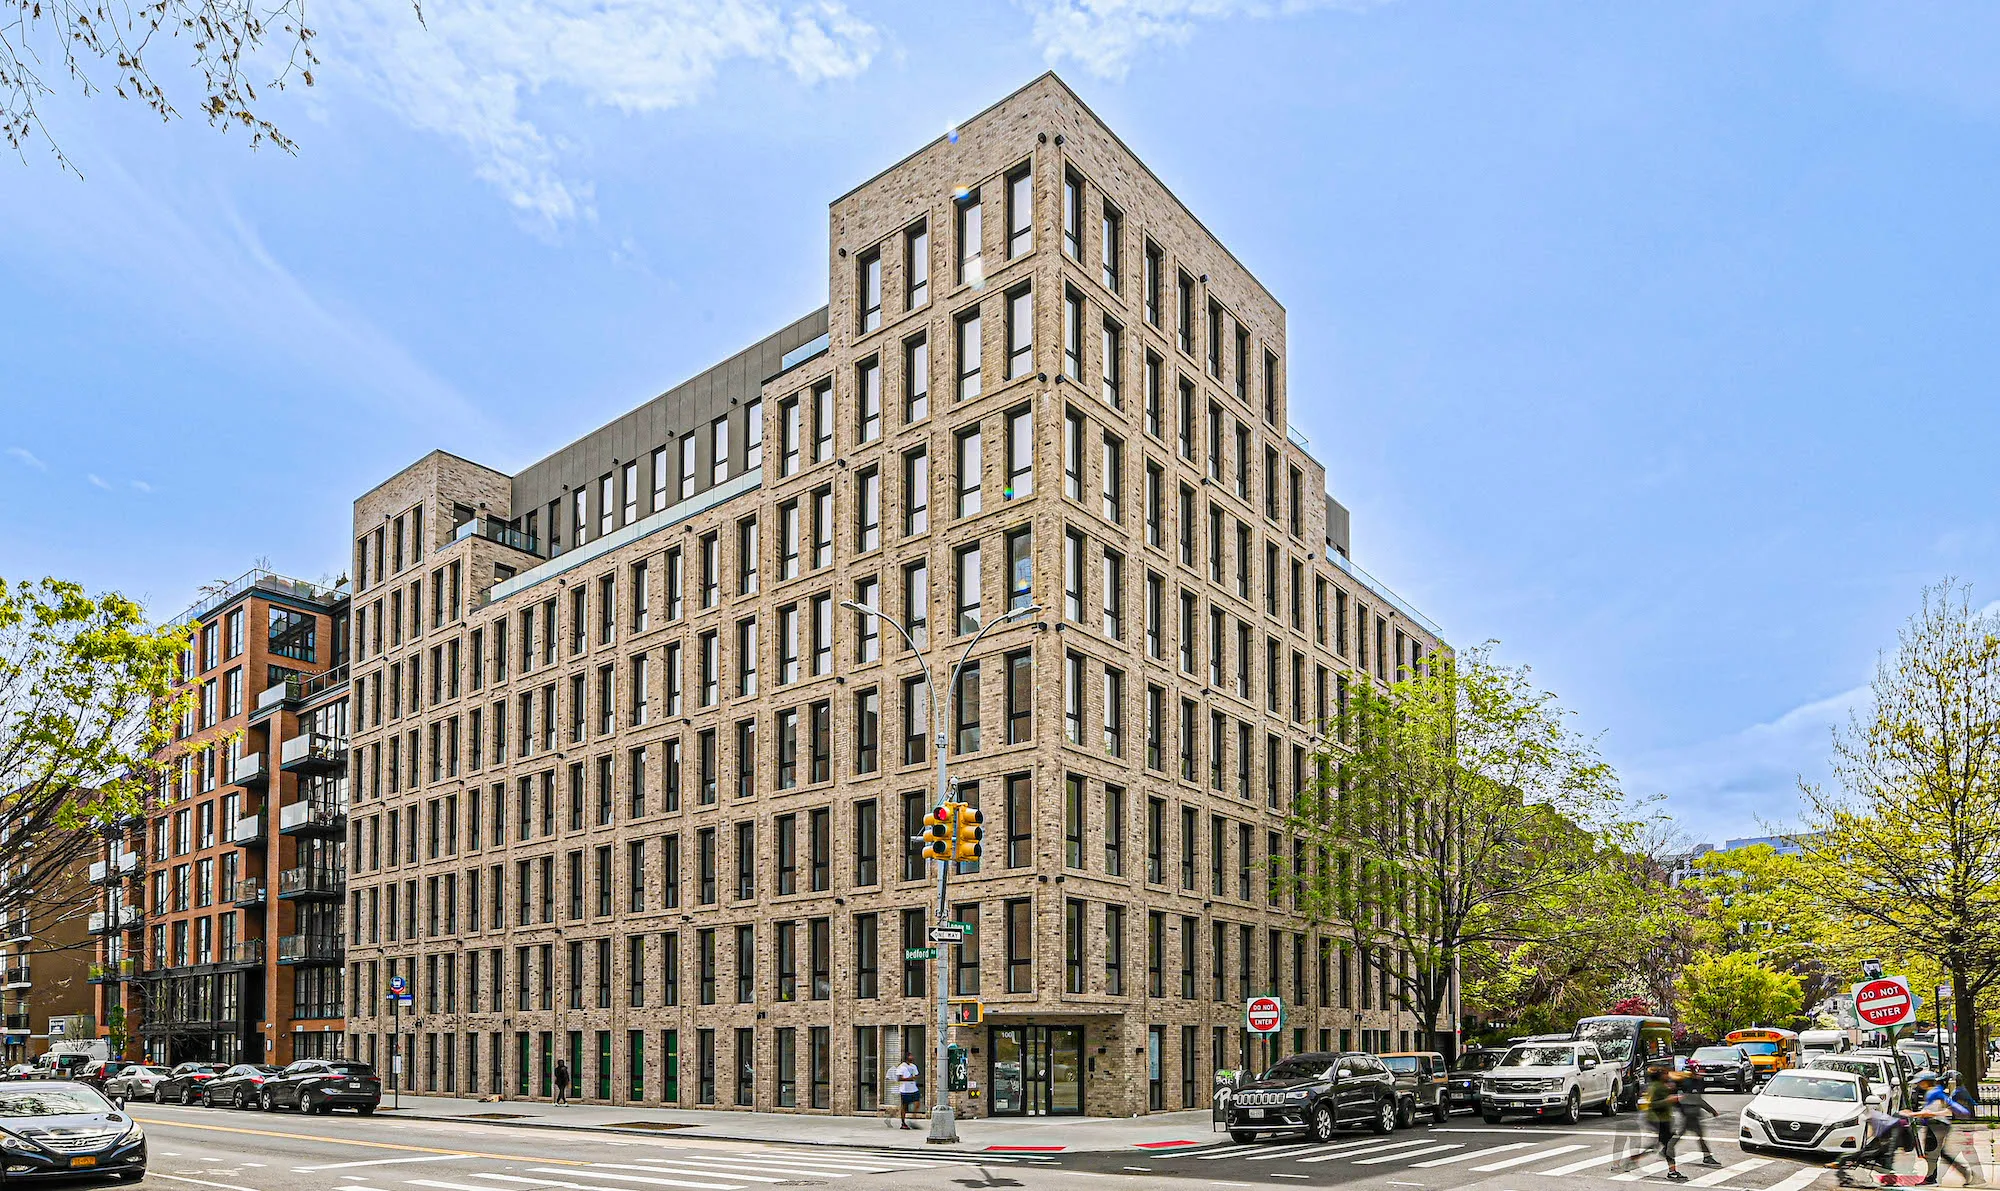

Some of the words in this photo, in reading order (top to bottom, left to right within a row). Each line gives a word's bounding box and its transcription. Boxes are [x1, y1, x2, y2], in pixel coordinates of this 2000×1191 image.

[906, 949, 930, 959] Bedford
[1861, 991, 1875, 1000] DO
[1880, 986, 1898, 997] NOT
[1870, 1007, 1900, 1019] ENTER
